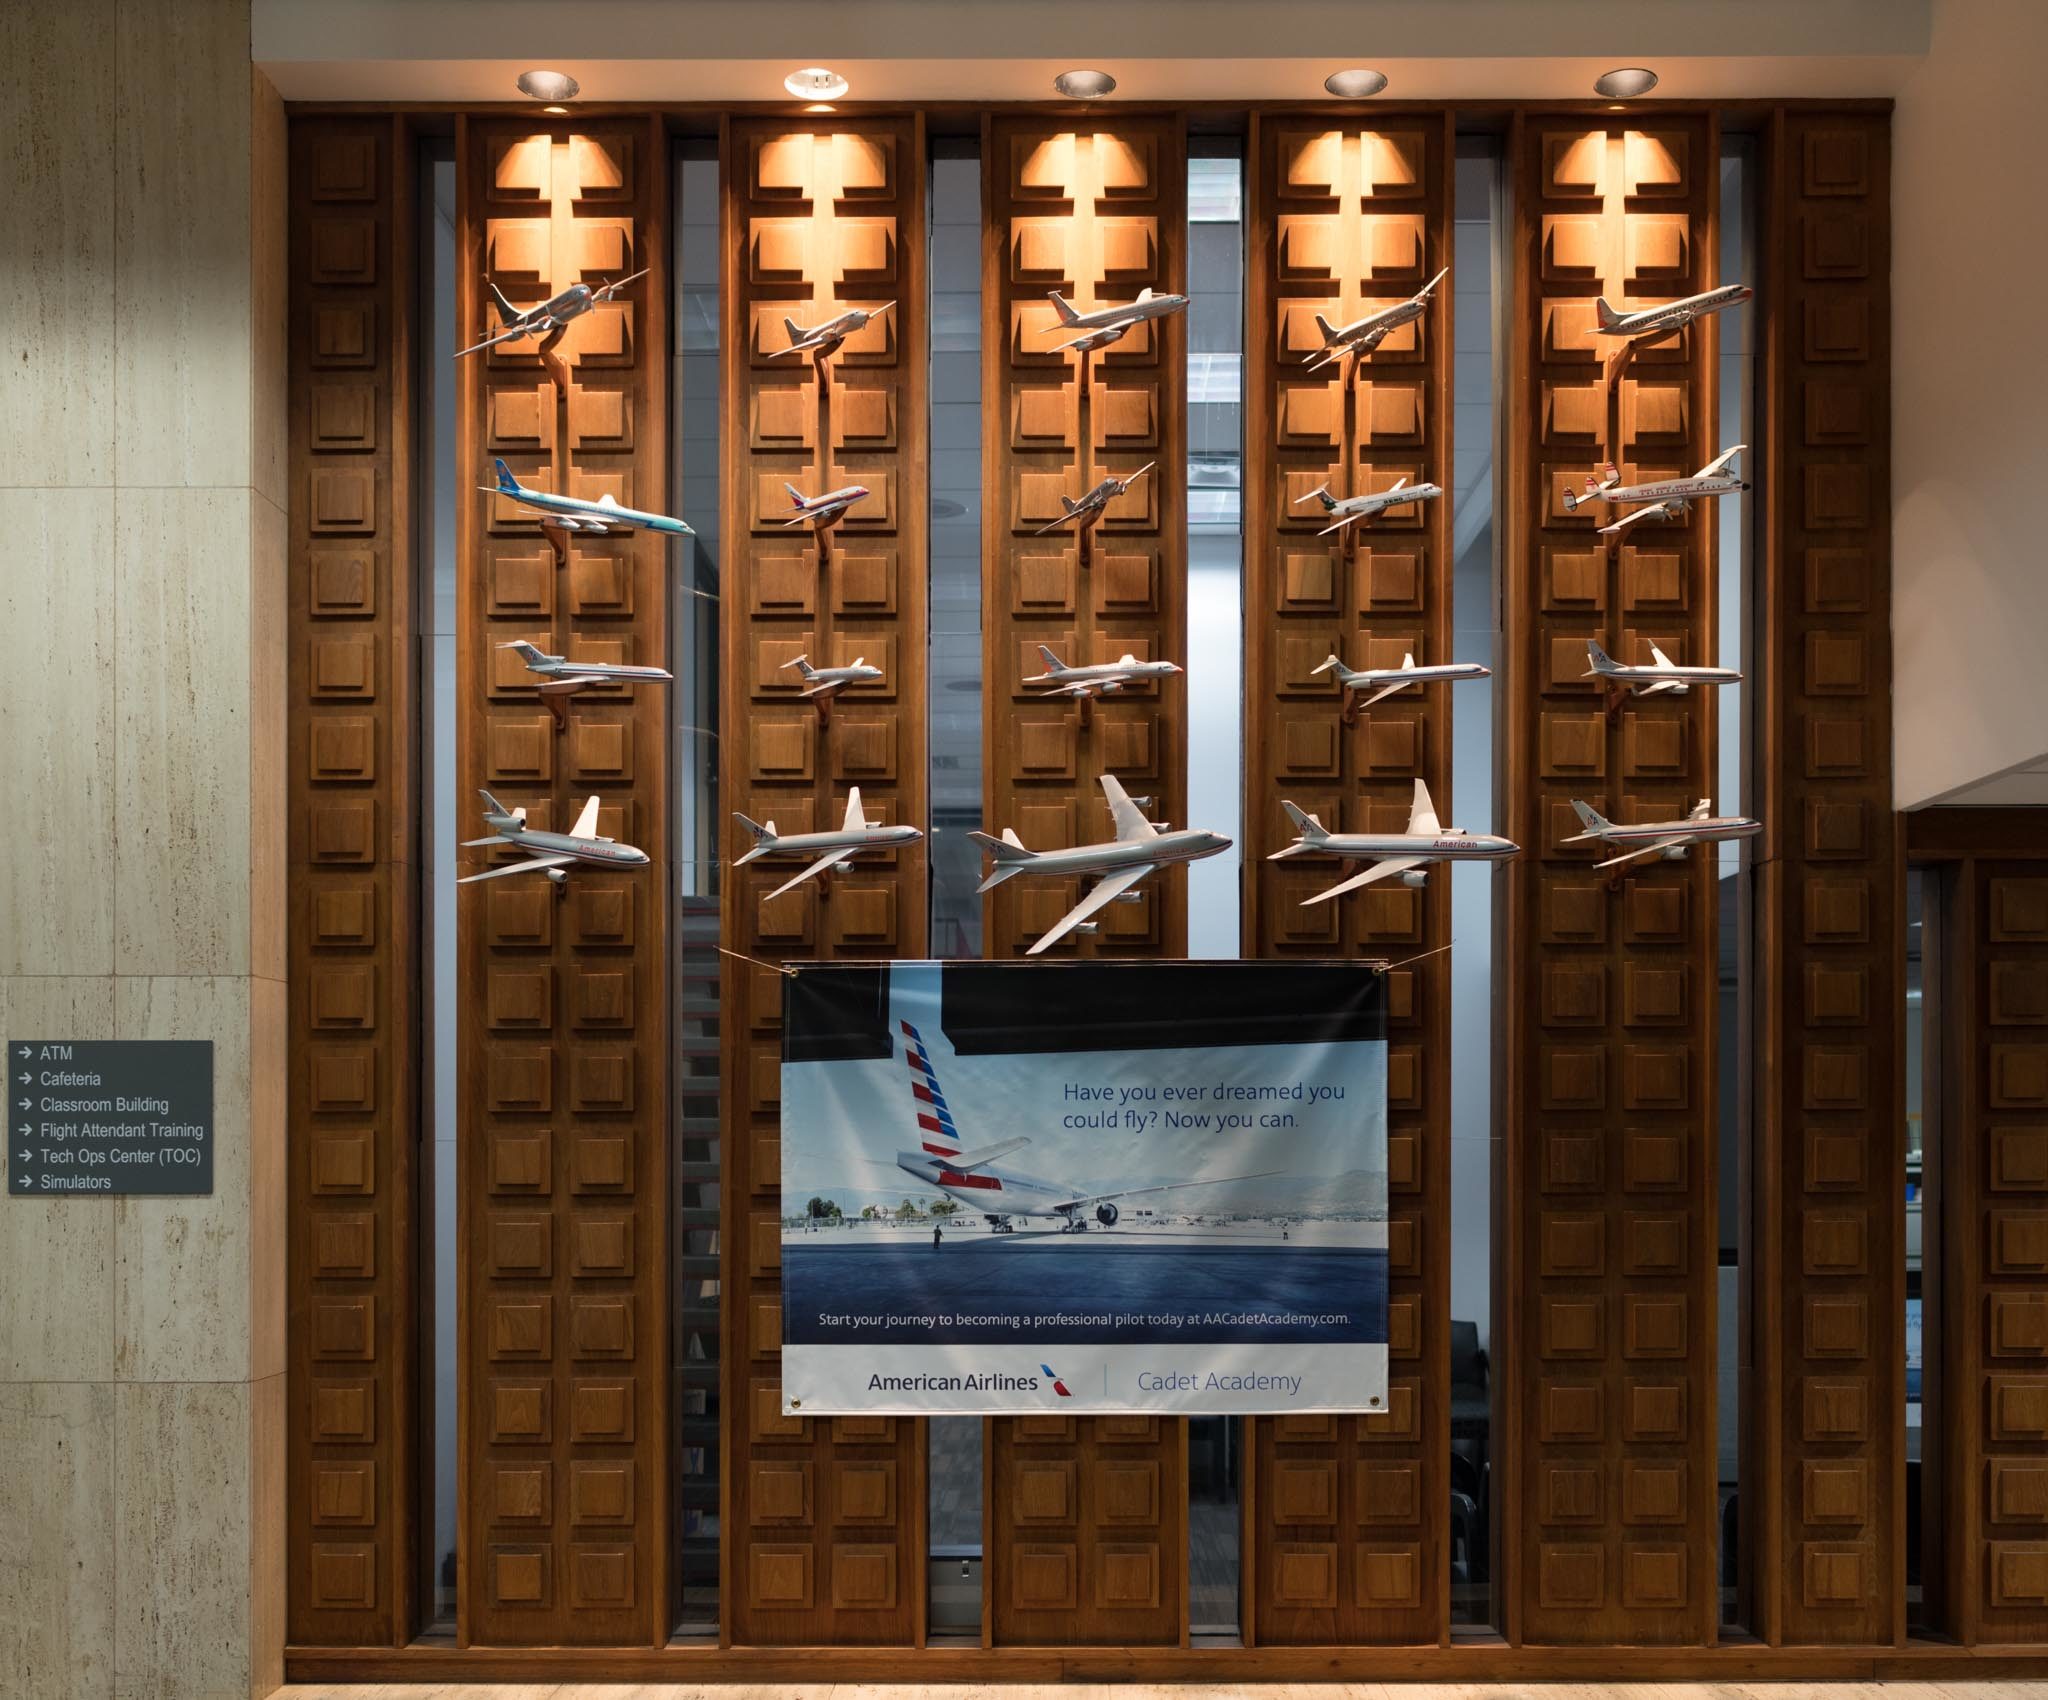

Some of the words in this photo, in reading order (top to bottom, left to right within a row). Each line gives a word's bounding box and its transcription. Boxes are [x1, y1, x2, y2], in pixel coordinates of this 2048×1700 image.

[577, 844, 616, 857] American
[1433, 840, 1478, 849] American
[40, 1046, 72, 1060] ATM
[40, 1071, 101, 1086] Cafeteria
[1064, 1083, 1114, 1101] Have
[1119, 1086, 1156, 1106] you
[1163, 1086, 1208, 1101] ever
[1213, 1081, 1303, 1101] dreamed
[1308, 1085, 1345, 1105] you
[40, 1097, 111, 1112] Classroom
[116, 1097, 169, 1115] Building
[1063, 1110, 1118, 1128] could
[1123, 1110, 1158, 1133] fly?
[1165, 1111, 1211, 1128] Now
[1215, 1114, 1252, 1133] you
[1259, 1114, 1299, 1128] can.
[41, 1123, 77, 1140] Flight
[81, 1123, 146, 1137] Attendant
[149, 1123, 204, 1140] Training
[41, 1149, 74, 1163] Tech
[78, 1149, 106, 1166] Ops
[110, 1149, 156, 1163] Center
[159, 1148, 201, 1166] (TOC)
[40, 1174, 112, 1189] Simulators
[819, 1313, 851, 1325] Start
[853, 1316, 883, 1329] your
[885, 1313, 936, 1329] journey
[939, 1314, 953, 1325] to
[956, 1313, 1020, 1329] becoming
[1023, 1315, 1031, 1325] a
[1034, 1313, 1111, 1328] professional
[1115, 1313, 1145, 1328] pilot
[1148, 1313, 1184, 1327] today
[1187, 1314, 1201, 1325] at
[1203, 1313, 1350, 1328] AACadetAcademy.com.
[868, 1373, 961, 1391] American
[964, 1373, 1038, 1391] Airlines
[1138, 1371, 1199, 1391] Cadet
[1204, 1371, 1302, 1396] Academy
